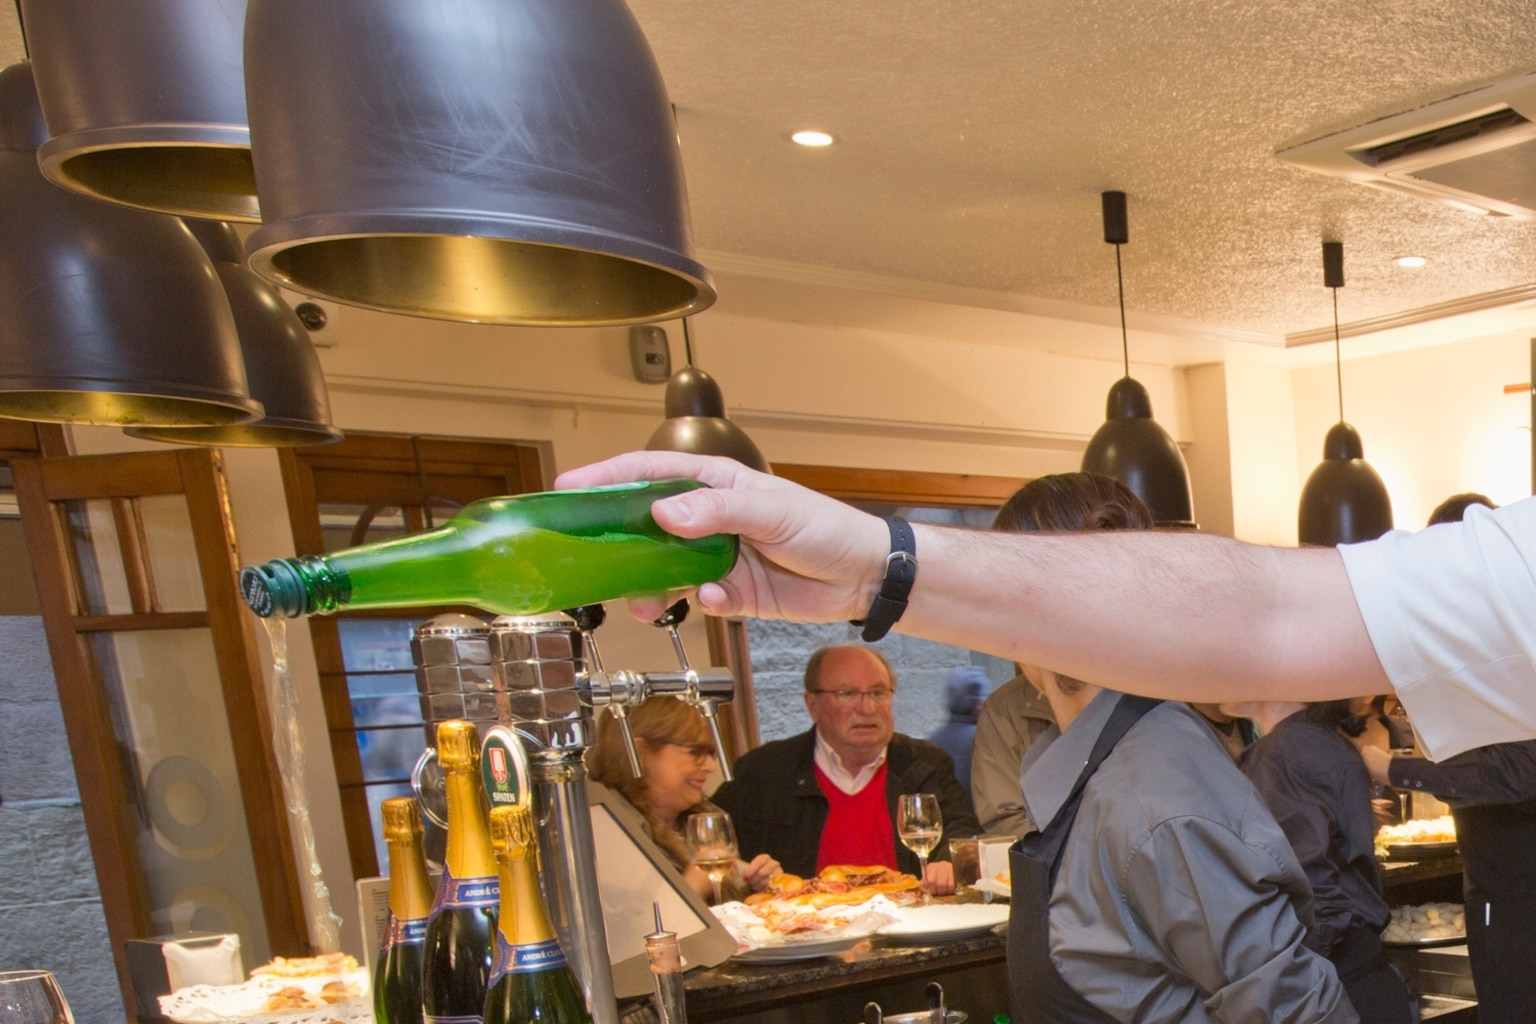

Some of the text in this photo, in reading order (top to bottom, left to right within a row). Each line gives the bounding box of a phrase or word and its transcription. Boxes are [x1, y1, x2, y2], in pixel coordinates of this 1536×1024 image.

[492, 792, 516, 803] SPATEN
[465, 887, 491, 897] ANDRÉ
[522, 950, 546, 961] ANDRÉ
